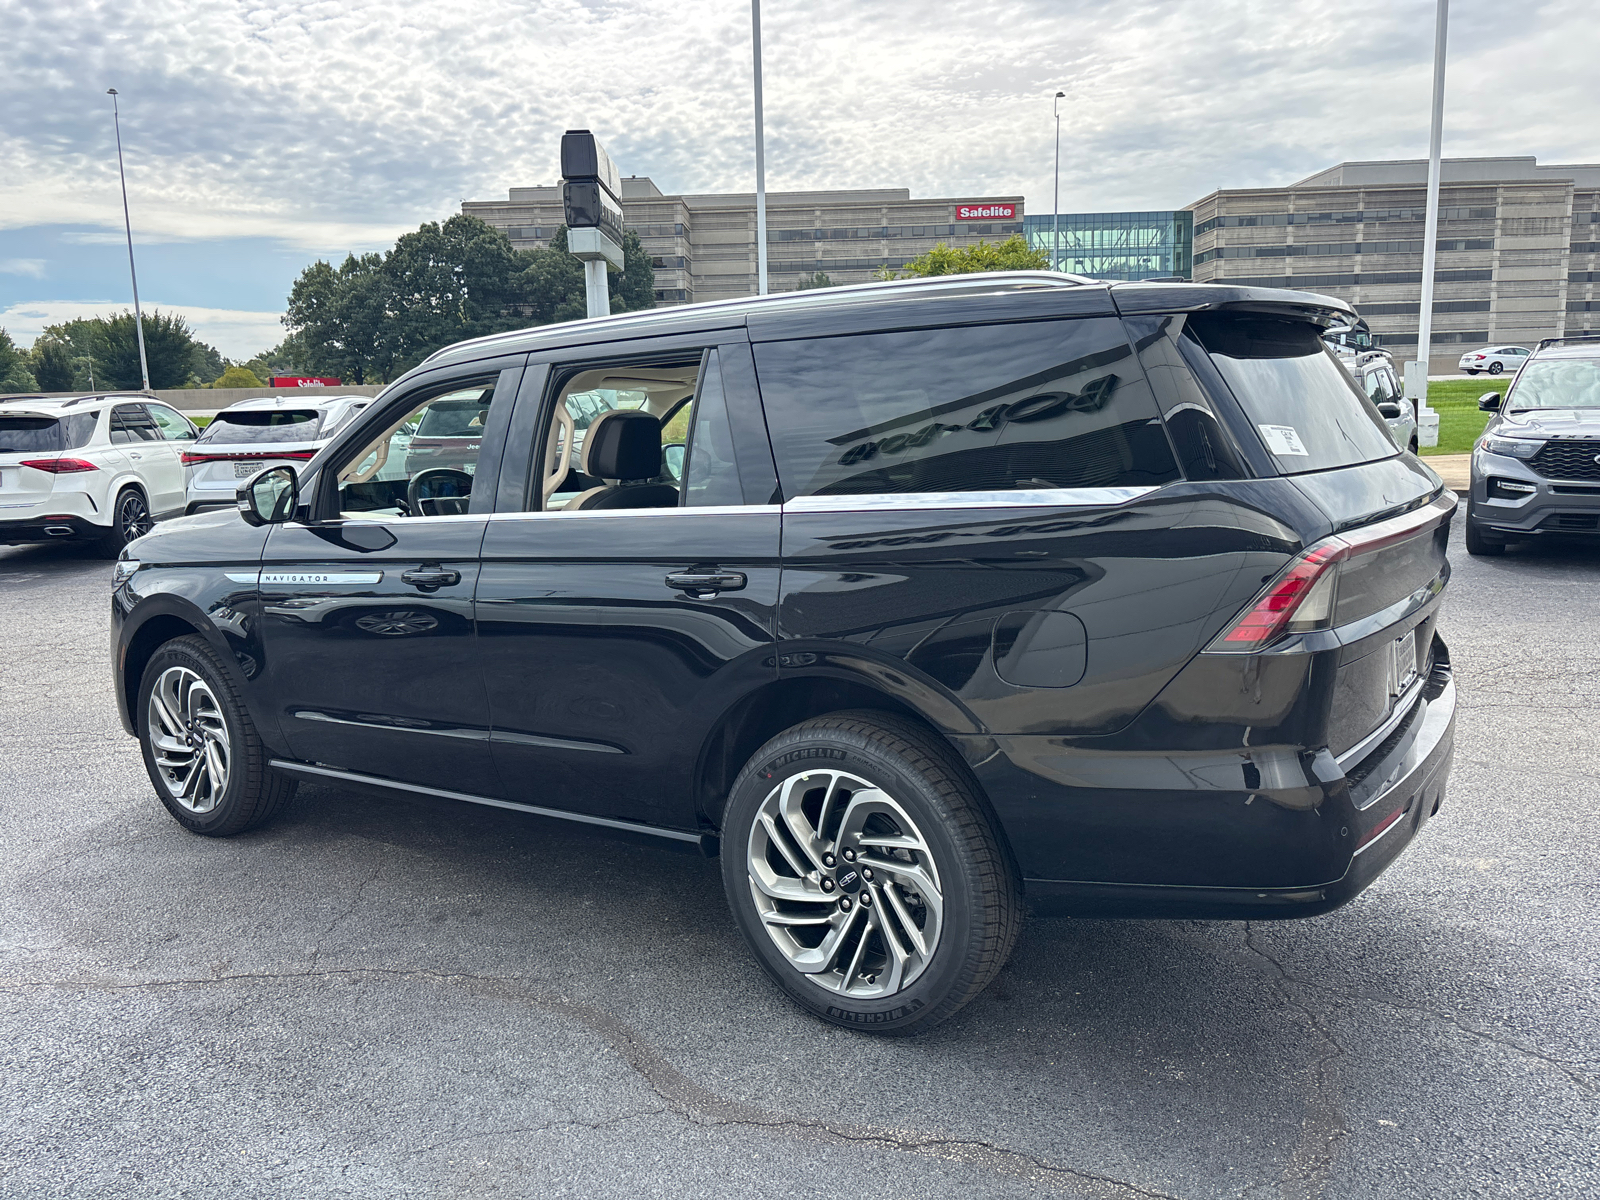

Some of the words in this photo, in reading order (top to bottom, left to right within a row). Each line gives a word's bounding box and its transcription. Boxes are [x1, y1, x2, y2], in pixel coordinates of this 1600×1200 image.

[960, 207, 1012, 217] Safelite
[775, 748, 842, 767] MICHELIN
[830, 1007, 904, 1022] MICHELIN
